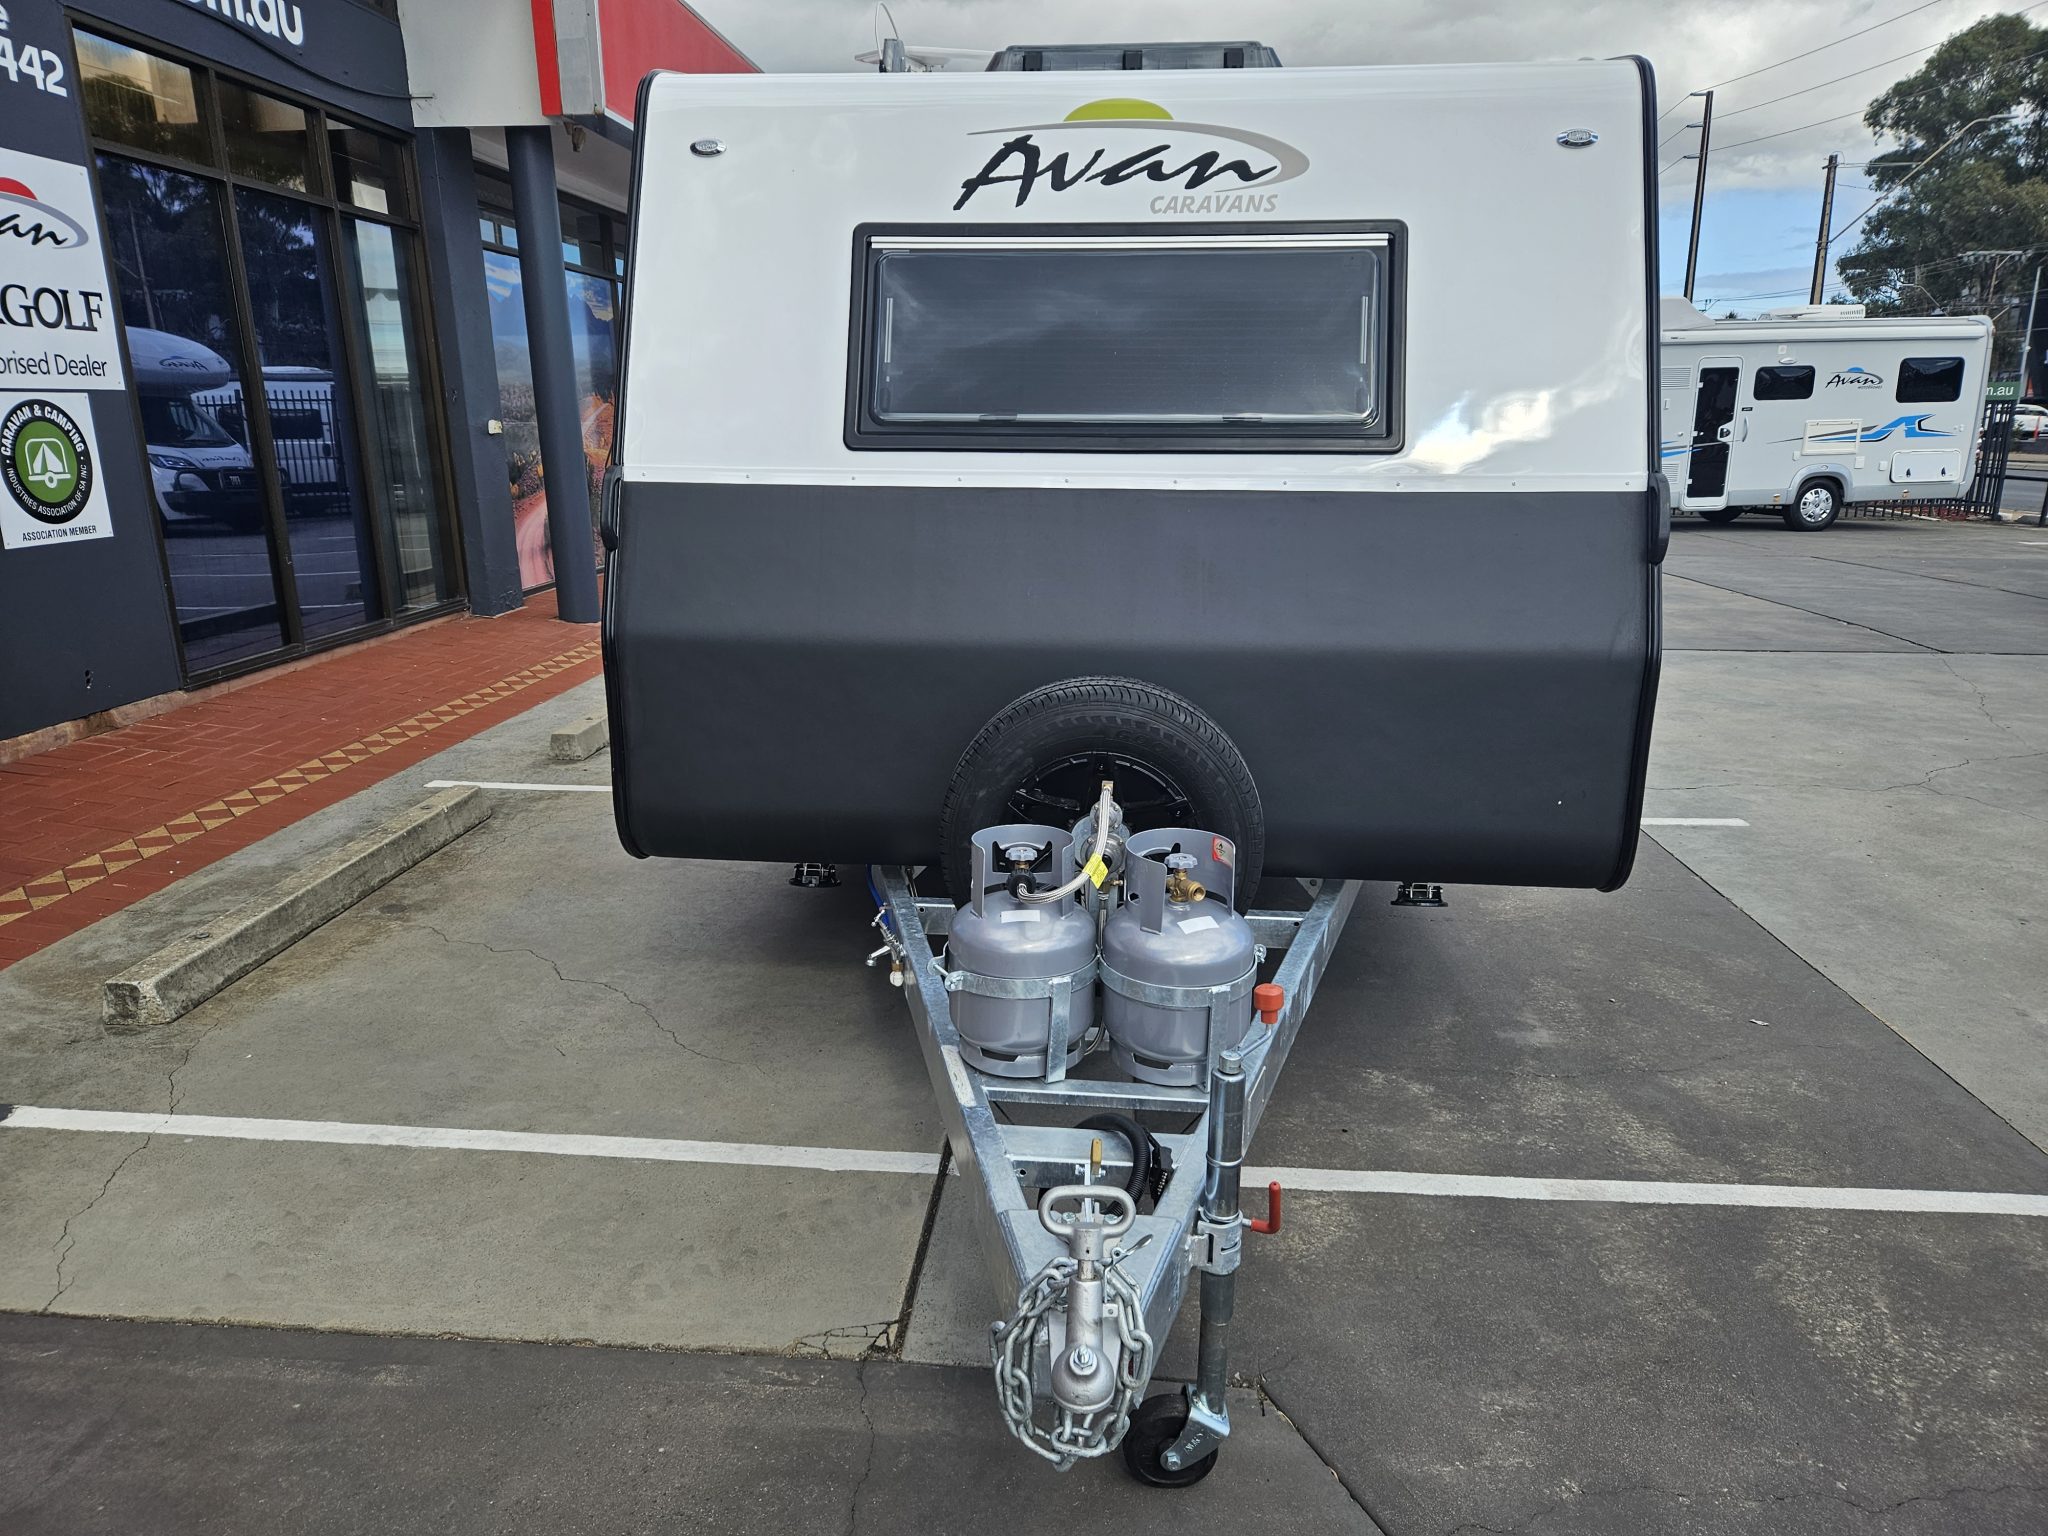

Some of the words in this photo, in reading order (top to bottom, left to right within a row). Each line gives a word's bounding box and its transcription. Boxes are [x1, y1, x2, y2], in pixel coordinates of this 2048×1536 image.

[953, 134, 1278, 211] Avan
[1149, 193, 1279, 215] CARAVANS
[0, 283, 103, 332] GOLF
[54, 353, 108, 377] Dealer
[1825, 373, 1878, 389] Avan
[1, 405, 32, 456] CARAVAN
[33, 404, 43, 417] &
[44, 406, 86, 453] CAMPING
[6, 467, 38, 510] INDUSTRIES
[74, 492, 84, 502] OF
[78, 480, 87, 492] SA
[37, 501, 78, 517] ASSOCIATION
[22, 529, 68, 541] ASSOCIATION
[69, 525, 97, 537] MEMBER
